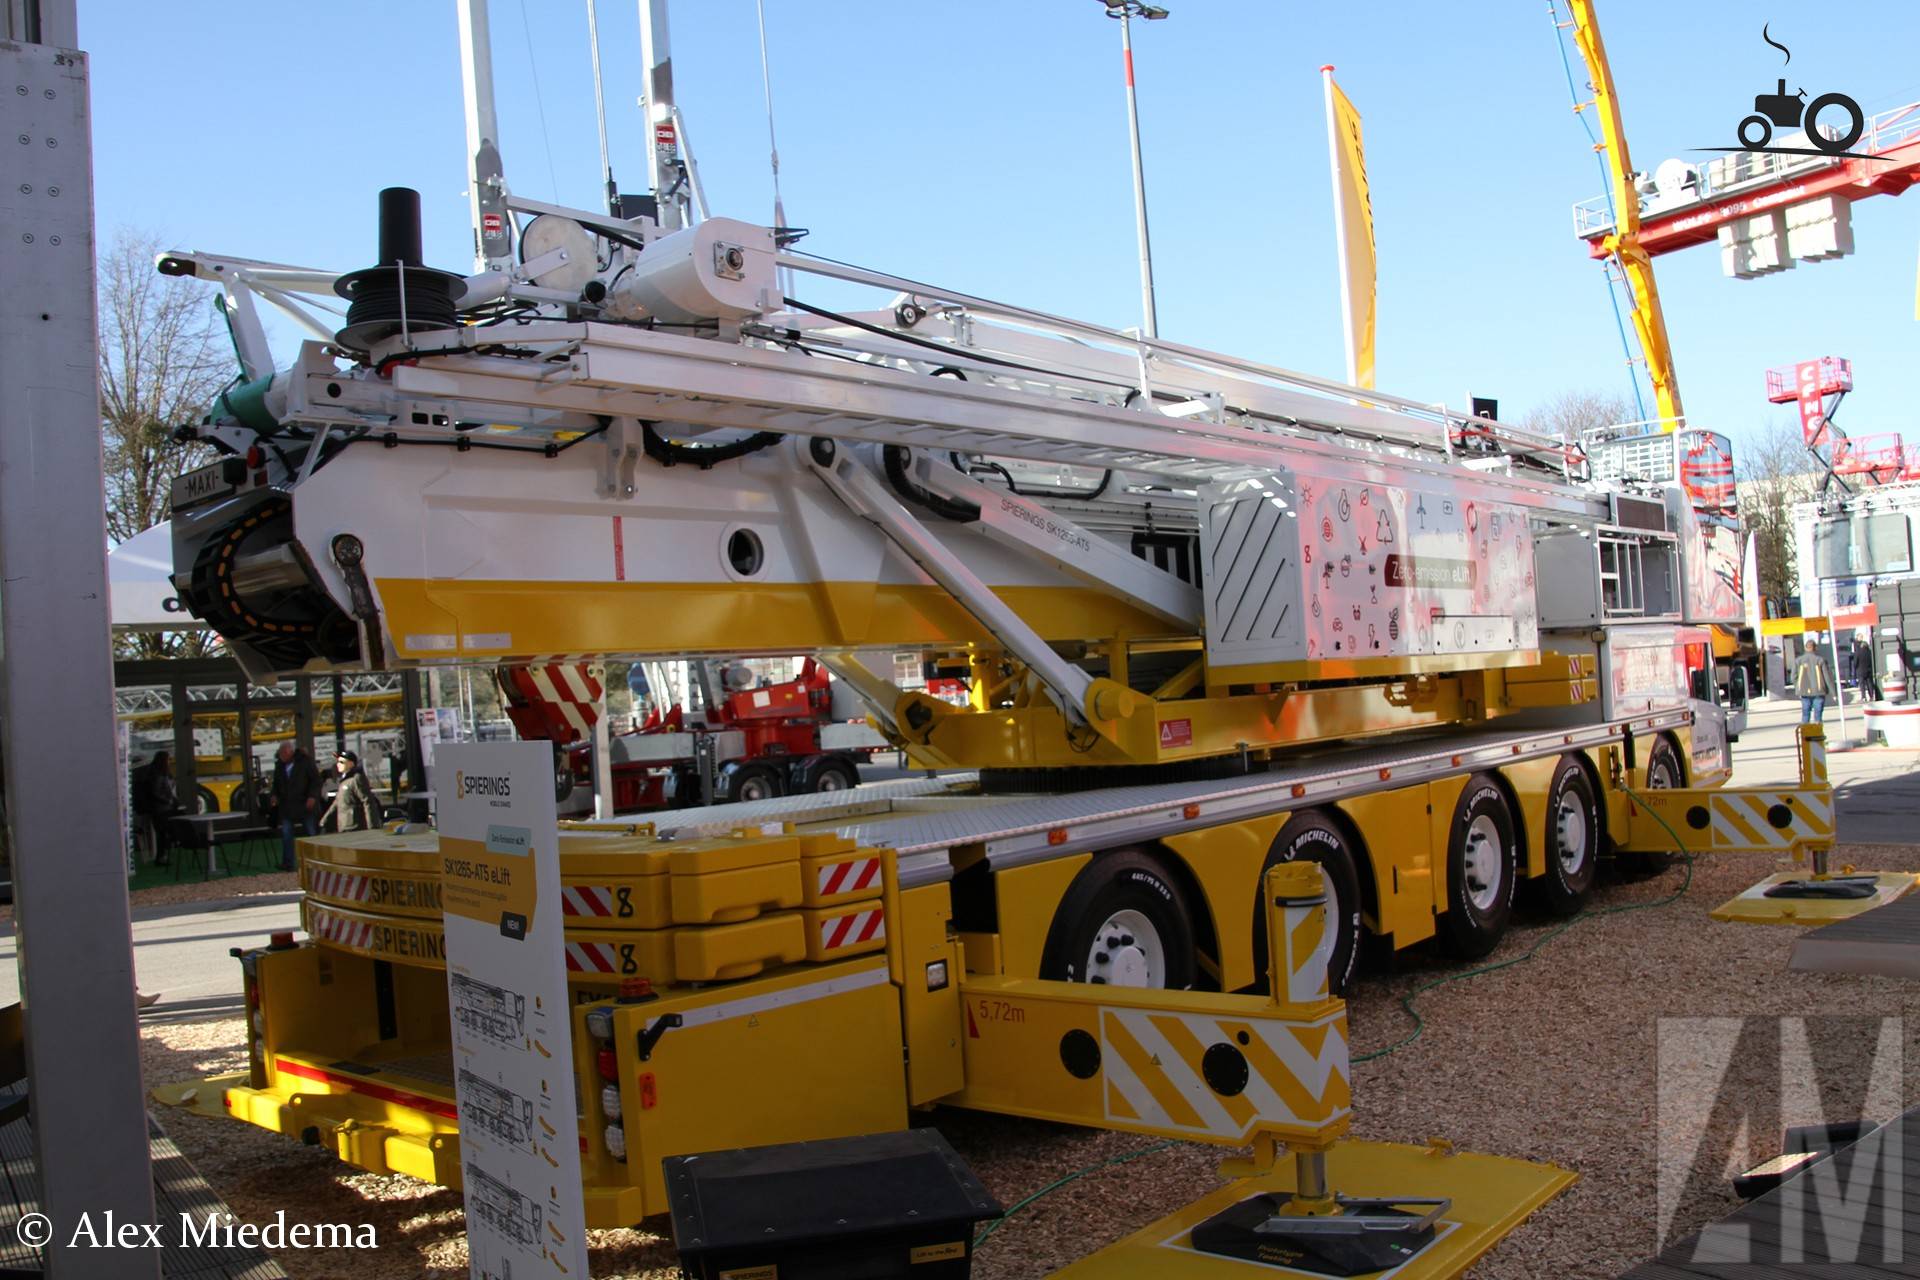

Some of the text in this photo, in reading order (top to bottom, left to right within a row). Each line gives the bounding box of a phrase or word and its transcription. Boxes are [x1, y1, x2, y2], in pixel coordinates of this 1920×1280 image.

[1000, 498, 1046, 530] SPIERINGS
[464, 776, 511, 796] SPIERINGS
[1470, 787, 1498, 809] MICHELIN
[1295, 829, 1339, 850] MICHELIN
[490, 867, 511, 886] eLift
[980, 1000, 1025, 1024] 5,72m
